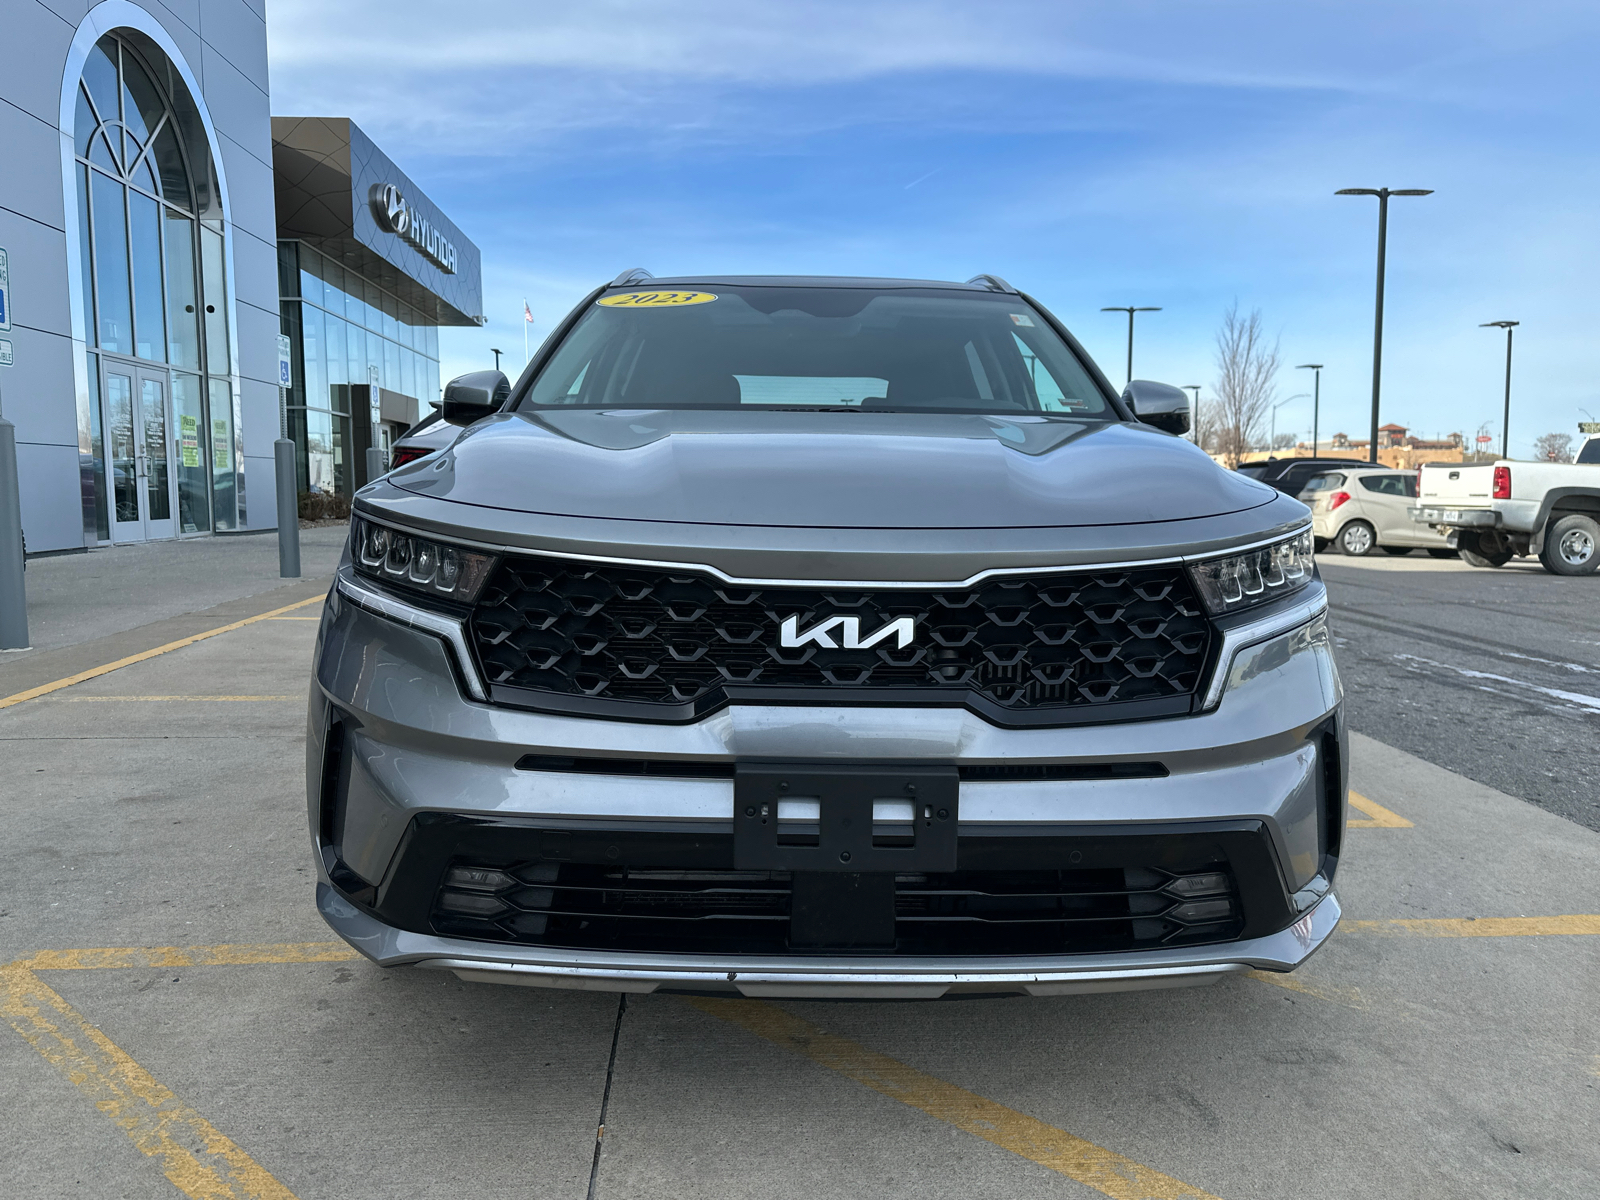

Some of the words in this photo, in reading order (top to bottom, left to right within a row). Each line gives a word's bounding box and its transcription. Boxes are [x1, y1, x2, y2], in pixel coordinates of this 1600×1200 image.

[410, 206, 457, 275] HYUNDAI
[612, 293, 698, 305] 2023
[781, 615, 914, 650] KIA
